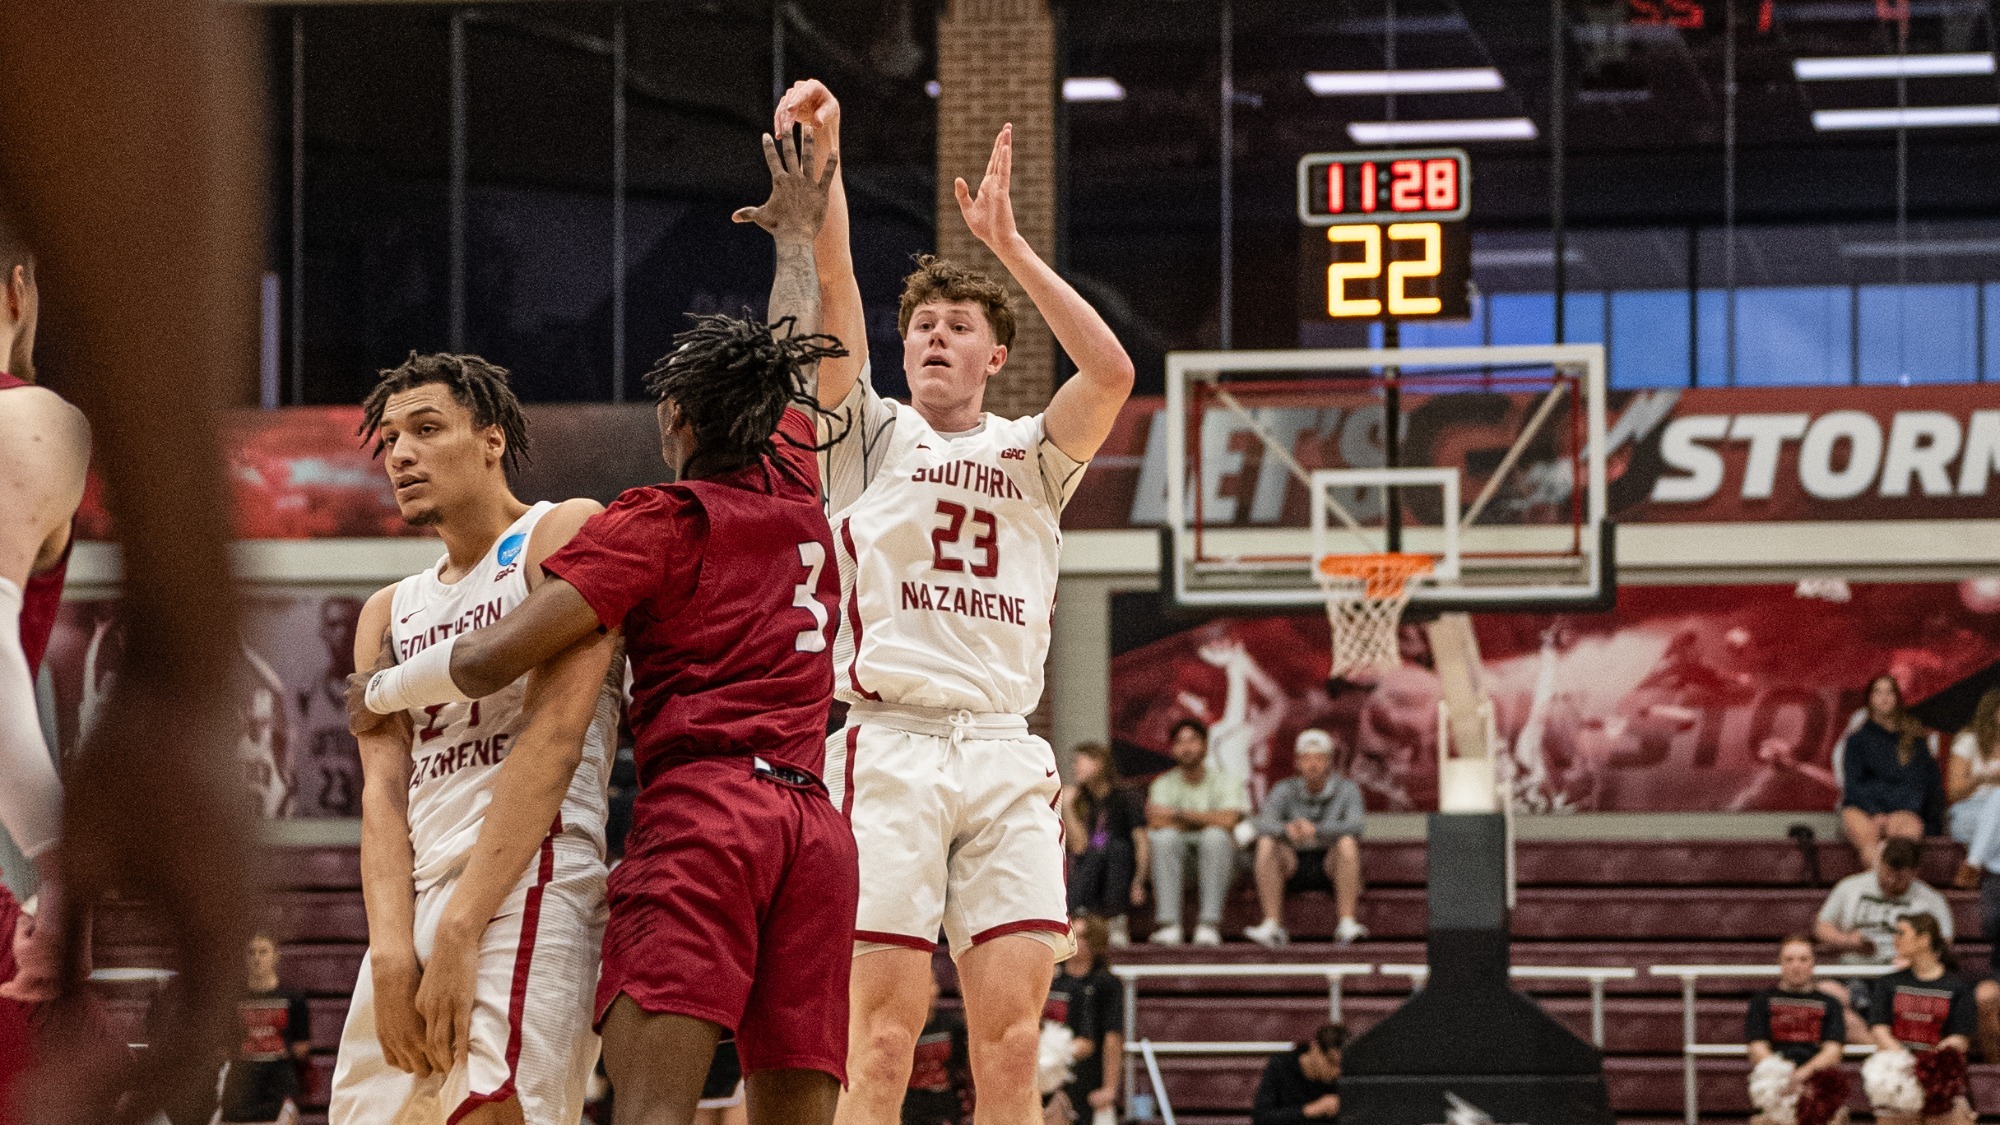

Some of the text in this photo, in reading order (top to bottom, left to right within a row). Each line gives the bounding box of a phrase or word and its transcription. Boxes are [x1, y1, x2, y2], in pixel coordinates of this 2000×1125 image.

[1328, 159, 1458, 214] 11:28
[1327, 223, 1442, 317] 22
[1001, 447, 1027, 461] GAC
[931, 498, 999, 579] 23
[791, 540, 829, 653] 3
[901, 581, 1026, 626] NAZARENE
